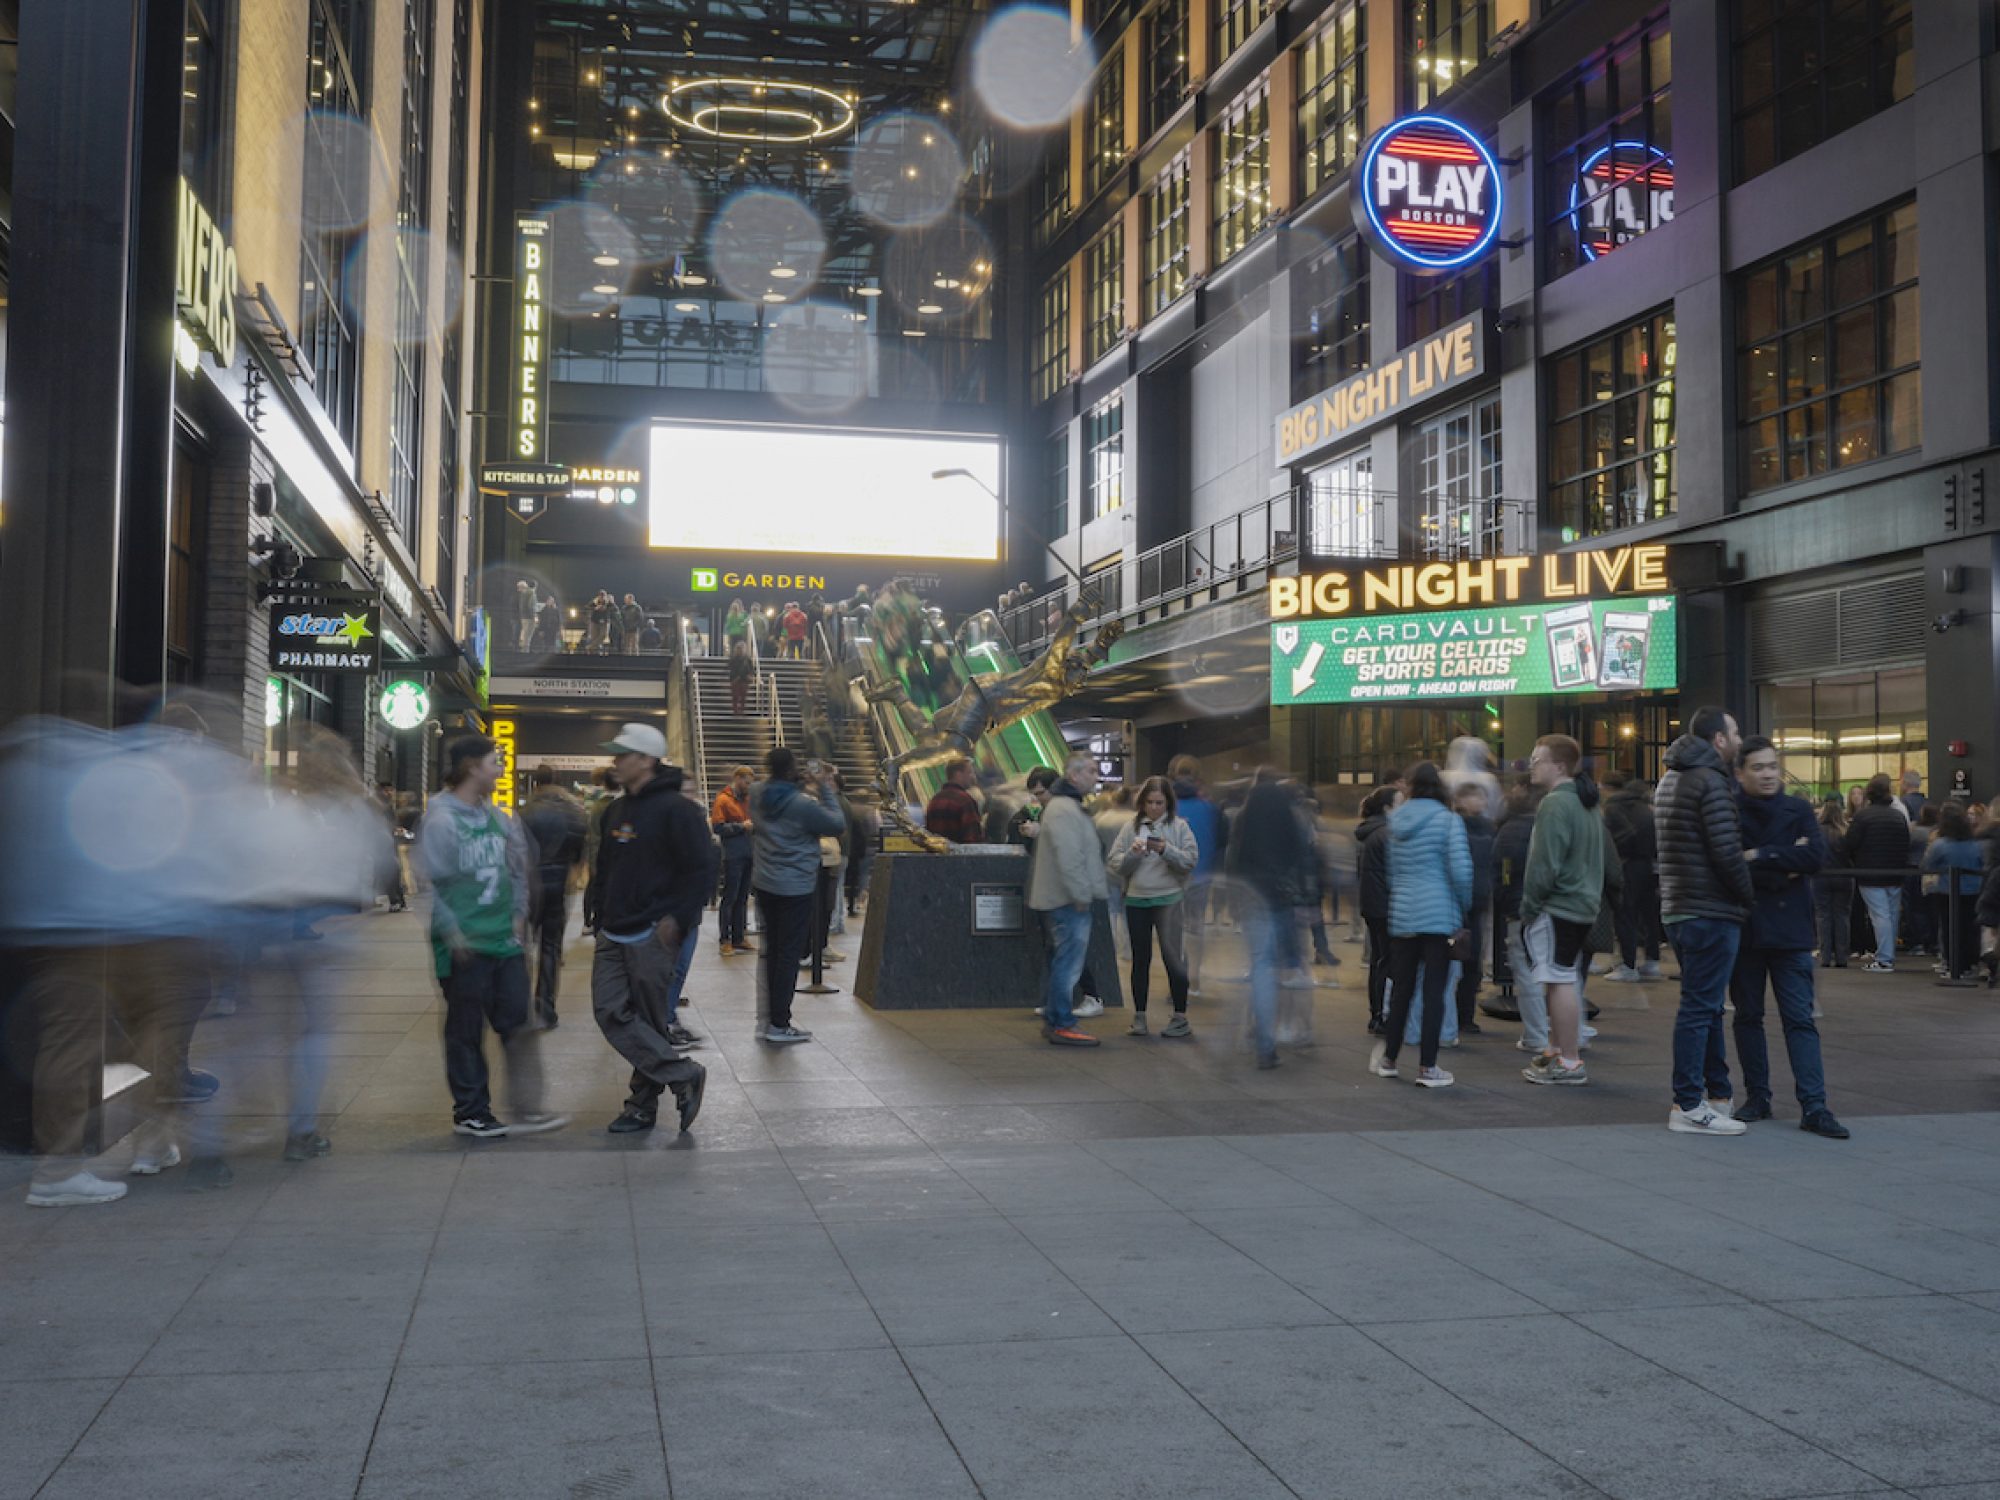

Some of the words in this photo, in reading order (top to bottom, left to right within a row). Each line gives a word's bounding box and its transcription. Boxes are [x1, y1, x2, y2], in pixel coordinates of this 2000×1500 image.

[1376, 154, 1488, 214] PLAY
[1401, 209, 1466, 226] BOSTON
[520, 242, 541, 457] BANNERS
[1281, 405, 1319, 459] BIG
[1323, 358, 1403, 438] NIGHT
[1408, 321, 1475, 398] LIVE
[484, 471, 534, 484] KITCHEN
[546, 474, 569, 485] TAP
[692, 571, 717, 588] TD
[722, 572, 825, 590] GARDEN
[1270, 573, 1350, 617] BIG
[1364, 557, 1530, 611] NIGHT
[1544, 545, 1667, 597] LIVE
[278, 613, 347, 636] star
[279, 652, 372, 668] PHARMACY
[1343, 646, 1381, 665] GET
[1384, 643, 1436, 663] YOUR
[1440, 638, 1527, 660] CELTICS
[1358, 661, 1436, 681] SPORTS
[1440, 657, 1511, 677] CARDS
[533, 679, 569, 688] NORTH
[570, 680, 611, 689] STATION
[1351, 685, 1382, 697] OPEN
[1383, 683, 1411, 696] NOW
[1418, 681, 1457, 695] AHEAD
[1459, 680, 1477, 693] ON
[1479, 678, 1518, 692] RIGHT
[475, 867, 499, 905] 7
